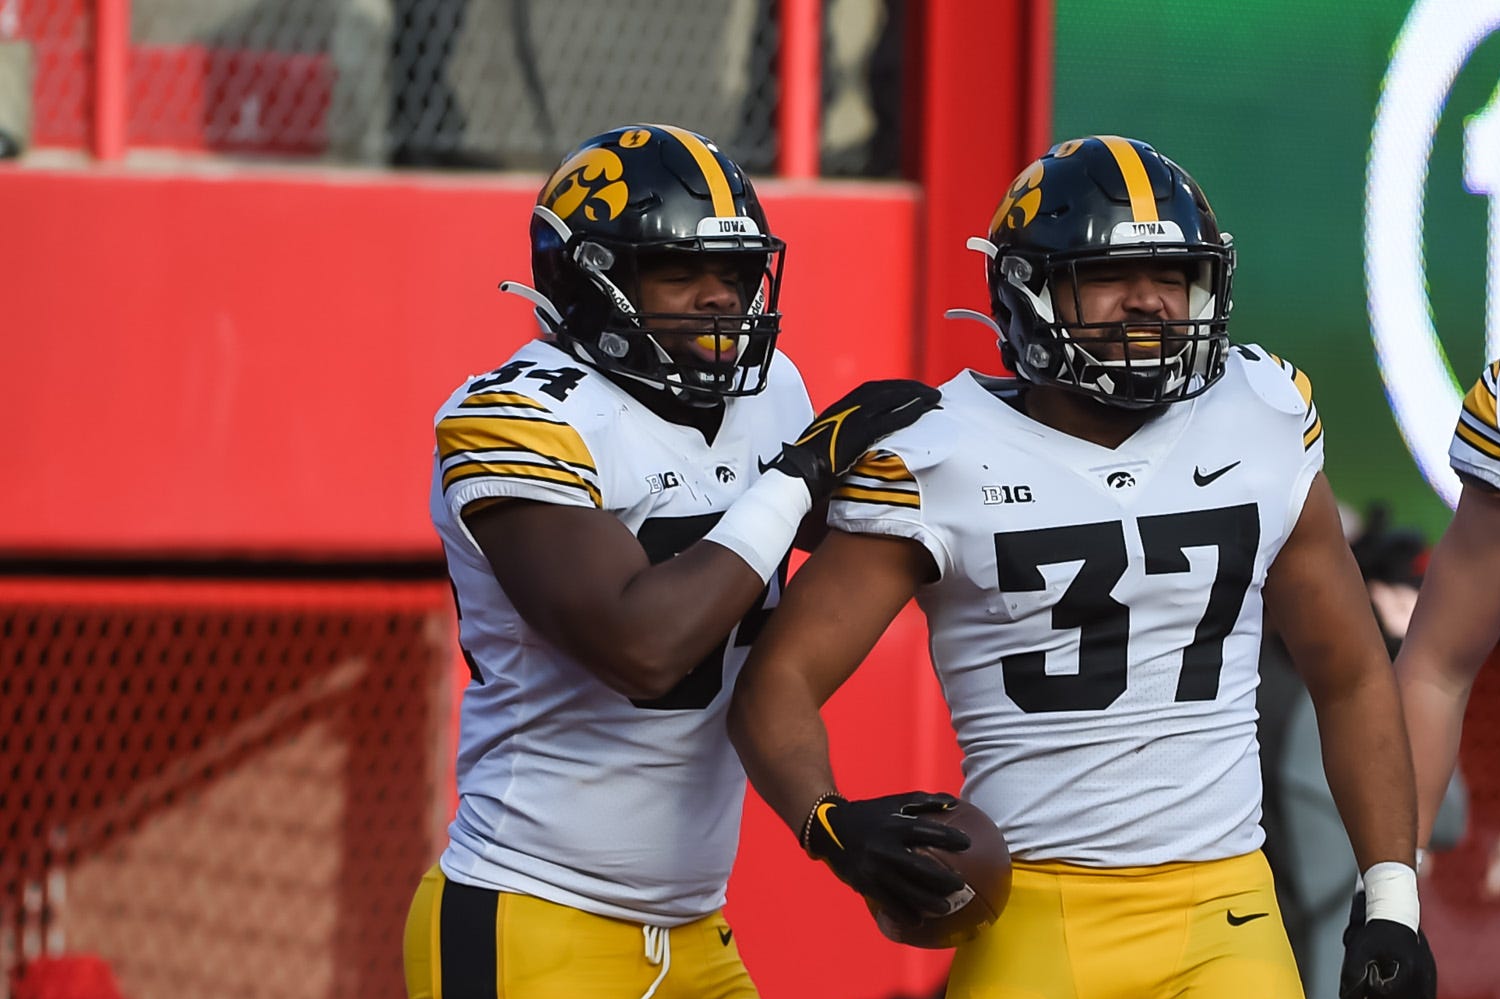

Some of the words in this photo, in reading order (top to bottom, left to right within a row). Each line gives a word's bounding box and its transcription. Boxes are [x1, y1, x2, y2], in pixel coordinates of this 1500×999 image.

[718, 220, 747, 233] IOWA
[1131, 222, 1166, 235] IOWA
[466, 360, 588, 403] 34
[993, 502, 1261, 714] 37
